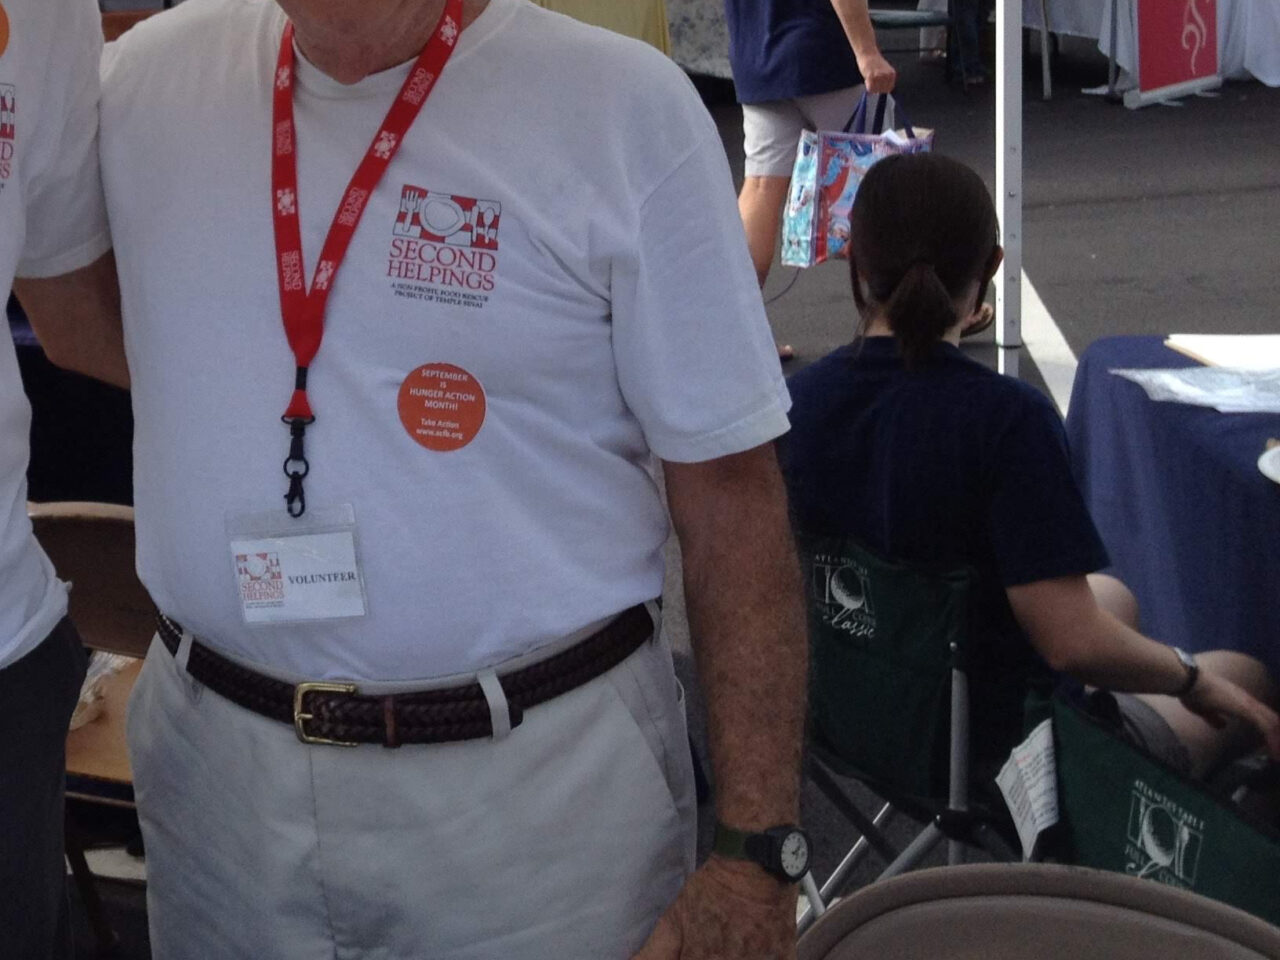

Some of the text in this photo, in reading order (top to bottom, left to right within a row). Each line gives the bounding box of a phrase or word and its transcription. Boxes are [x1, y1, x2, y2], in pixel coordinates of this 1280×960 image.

[337, 187, 359, 224] SECOND
[389, 238, 496, 273] SECOND
[387, 260, 495, 292] HELPINGS
[435, 296, 462, 306] TEMPLE
[421, 369, 468, 382] SEPTEMBER
[440, 381, 447, 389] IS
[410, 387, 475, 402] HUNGER ACTION
[425, 400, 458, 411] MONTH!
[421, 418, 459, 429] Take Action
[288, 571, 356, 585] VOLUNTEER
[241, 580, 284, 593] SECOND
